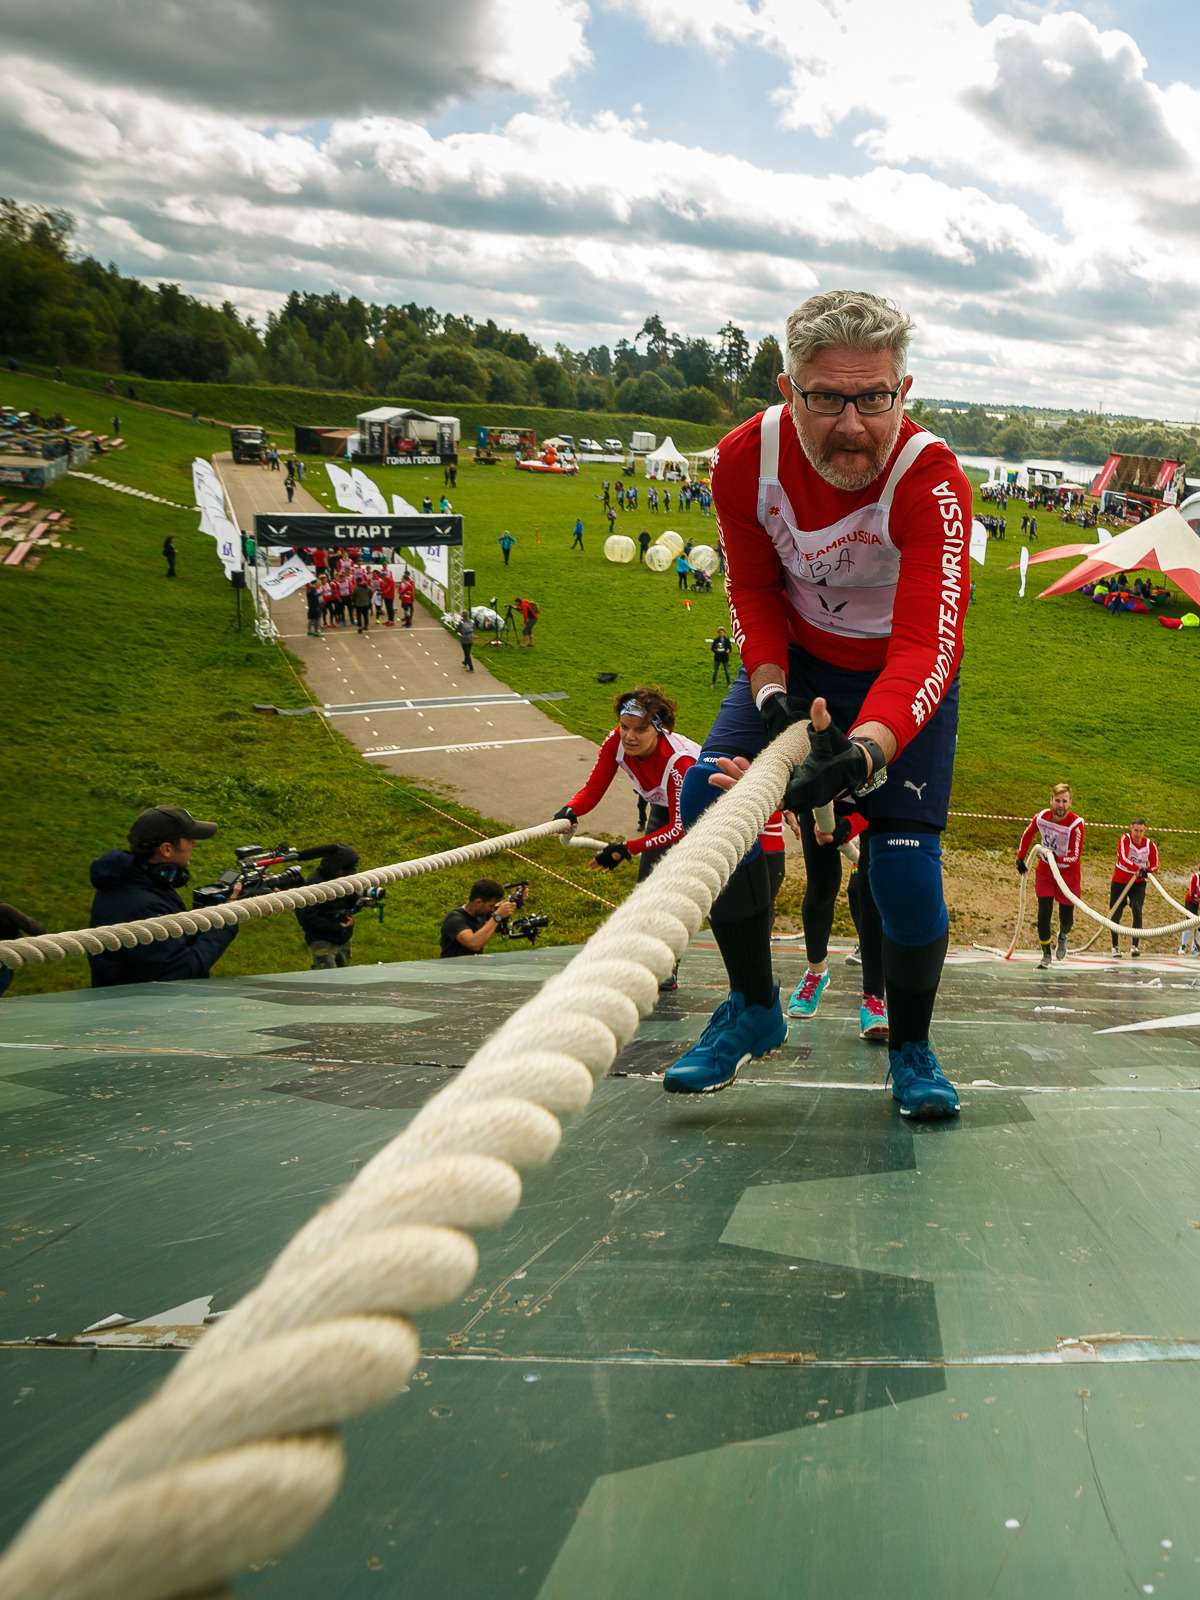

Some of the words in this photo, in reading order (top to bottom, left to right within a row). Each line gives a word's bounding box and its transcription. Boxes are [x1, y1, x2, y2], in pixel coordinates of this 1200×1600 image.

[386, 456, 412, 465] ГОНКА
[413, 455, 441, 464] ГЕРОЕВ
[334, 525, 393, 539] СТАРТ
